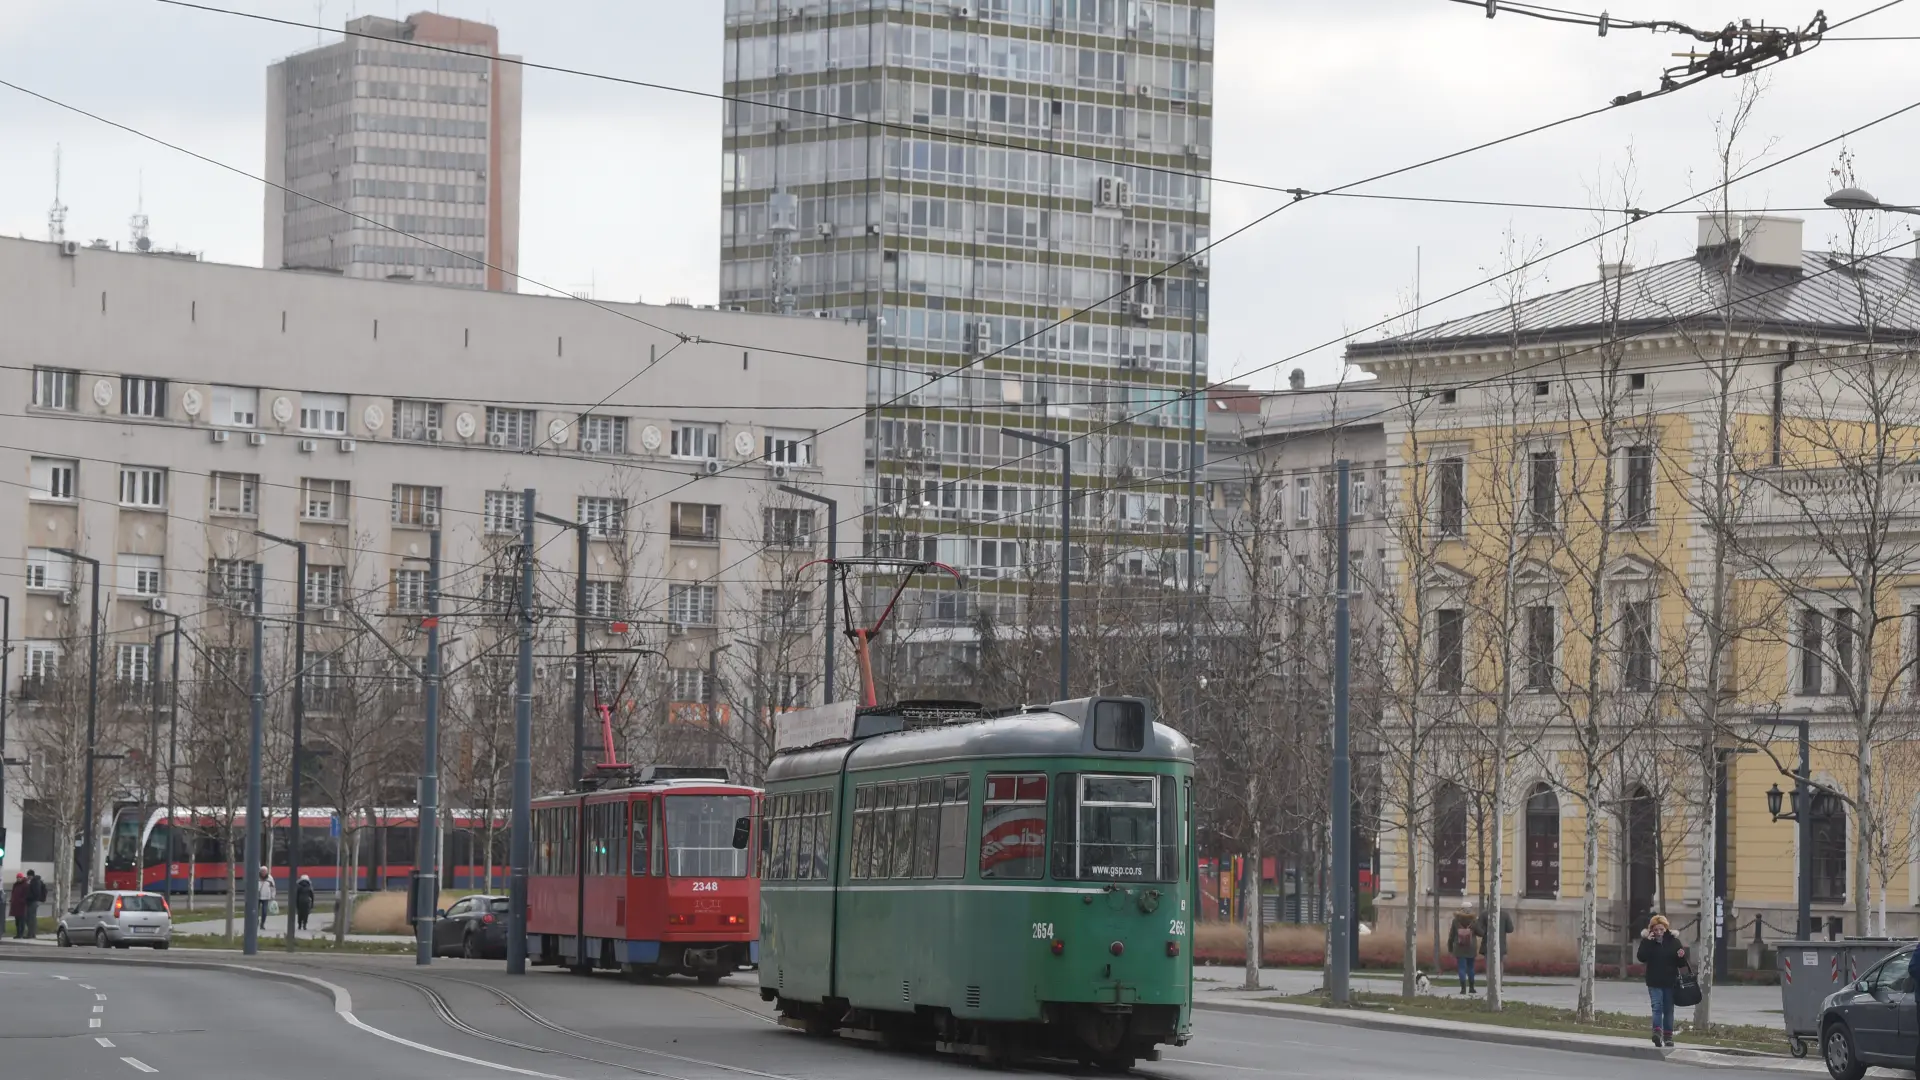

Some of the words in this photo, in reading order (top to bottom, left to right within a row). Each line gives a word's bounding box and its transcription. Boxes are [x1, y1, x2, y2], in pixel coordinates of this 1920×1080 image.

[1092, 865, 1142, 877] www.gsp.co.rs
[692, 881, 718, 892] 2348
[1032, 922, 1054, 939] 2654
